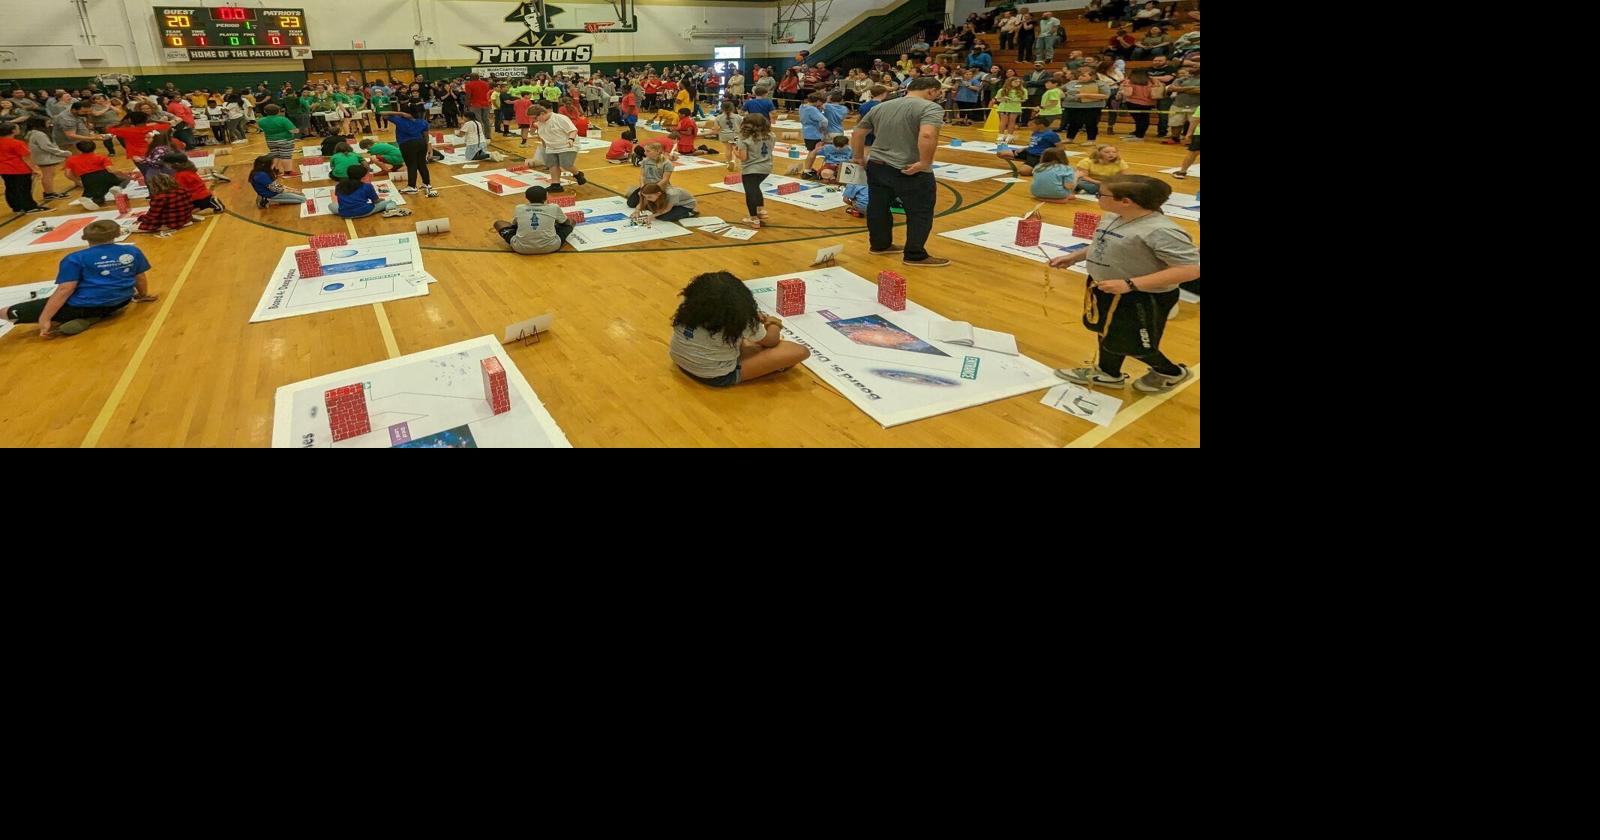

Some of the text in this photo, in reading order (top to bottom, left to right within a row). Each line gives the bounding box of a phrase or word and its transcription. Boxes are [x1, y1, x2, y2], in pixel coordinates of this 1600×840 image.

[167, 15, 191, 28] 20
[246, 21, 251, 30] 1
[280, 16, 300, 28] 23
[172, 37, 183, 46] 0
[200, 37, 205, 45] 1
[230, 37, 240, 45] 0
[251, 37, 255, 45] 1
[272, 37, 280, 45] 0
[298, 37, 303, 45] 1
[190, 50, 217, 58] HOME
[218, 50, 231, 58] OF
[249, 49, 290, 57] PATRIOTS
[480, 46, 591, 63] PATRIOTS
